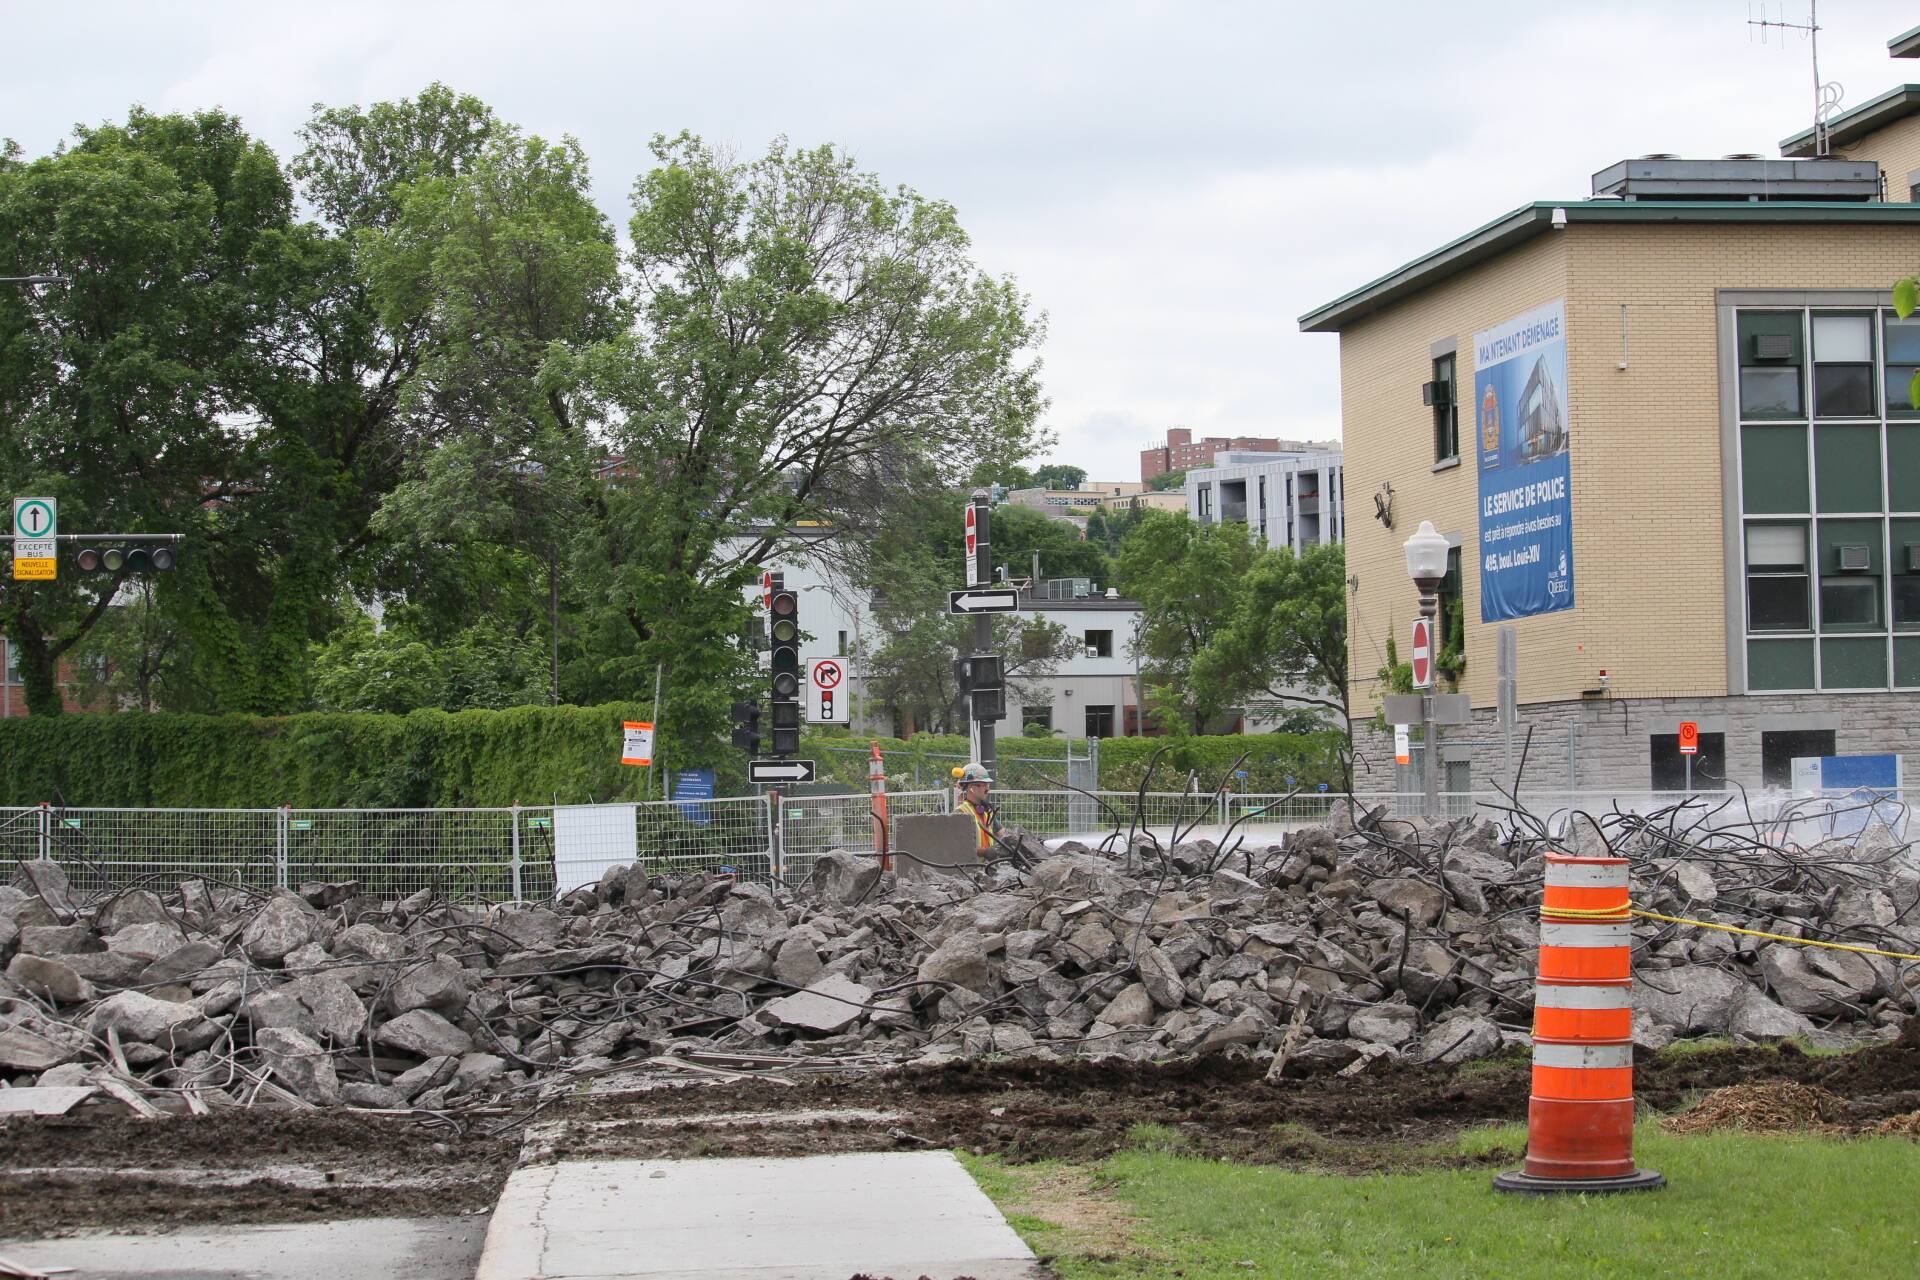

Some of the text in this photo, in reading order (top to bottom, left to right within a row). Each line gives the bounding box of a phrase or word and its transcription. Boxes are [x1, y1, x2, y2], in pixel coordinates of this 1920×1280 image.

[1522, 312, 1559, 348] DÉMÉNAGÉ
[1484, 476, 1565, 517] LE SERVICE DE POLICE
[1528, 520, 1537, 533] vos
[1537, 514, 1555, 530] besoins
[1555, 513, 1562, 526] au
[17, 542, 53, 550] EXCEPTÉ
[1513, 544, 1541, 567] Louis-XIV
[1547, 578, 1568, 598] QUÉBEC
